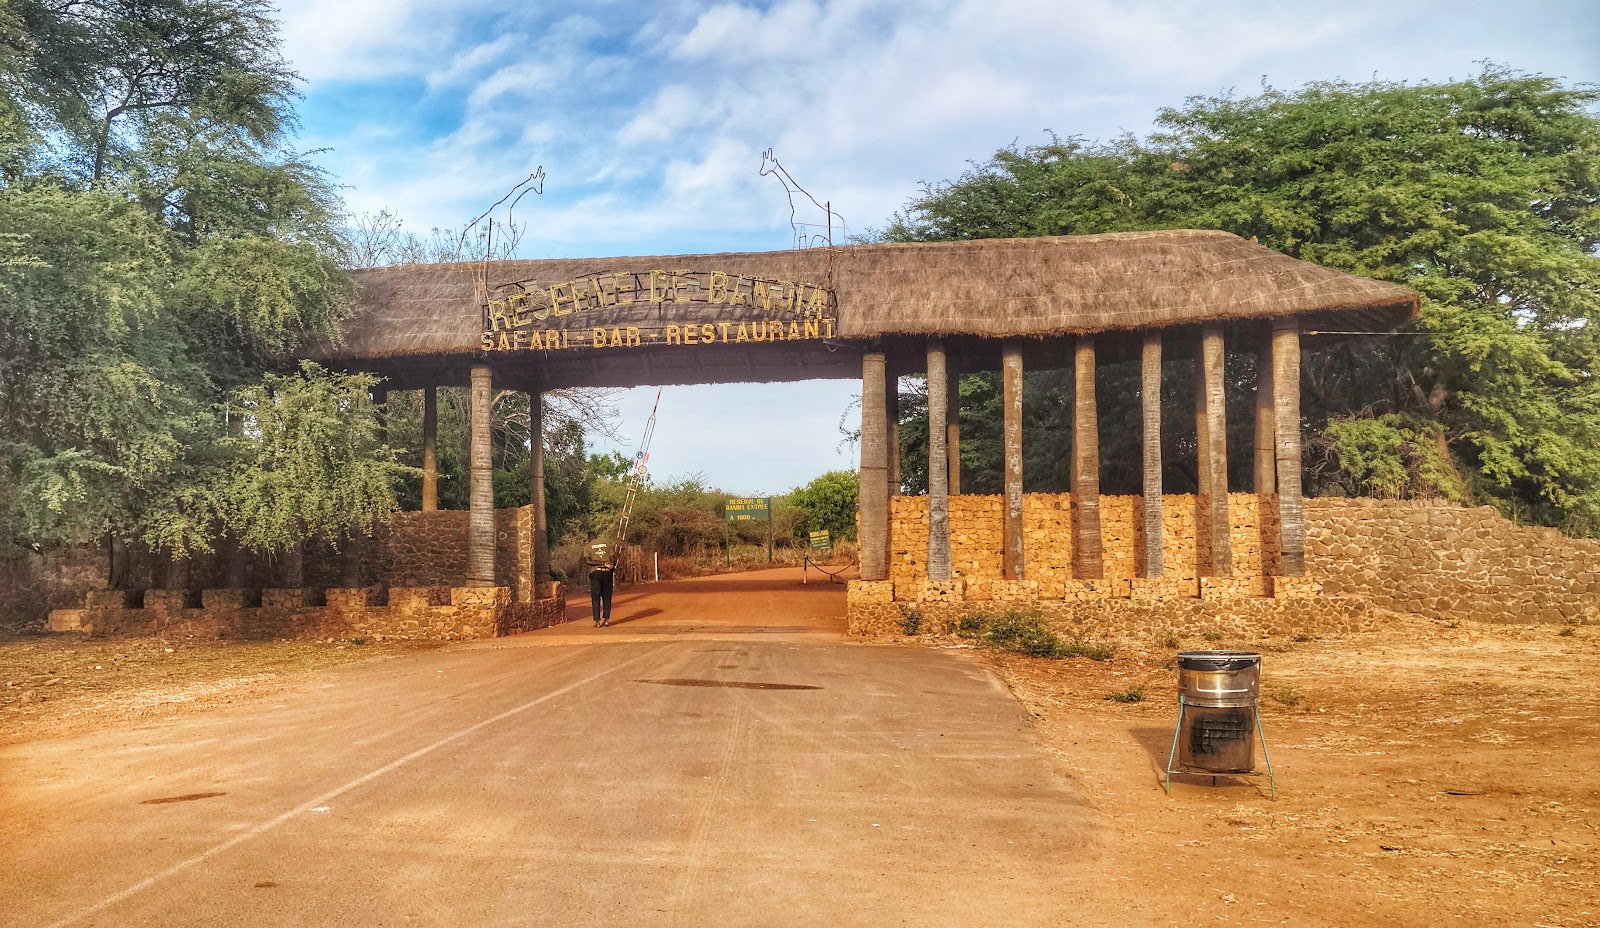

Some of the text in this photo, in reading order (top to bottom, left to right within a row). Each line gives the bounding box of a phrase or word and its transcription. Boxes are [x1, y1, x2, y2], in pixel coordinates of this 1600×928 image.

[650, 269, 691, 303] DE
[481, 329, 568, 351] SAFARI
[593, 327, 641, 348] BAR
[666, 317, 836, 346] RESTAURANT
